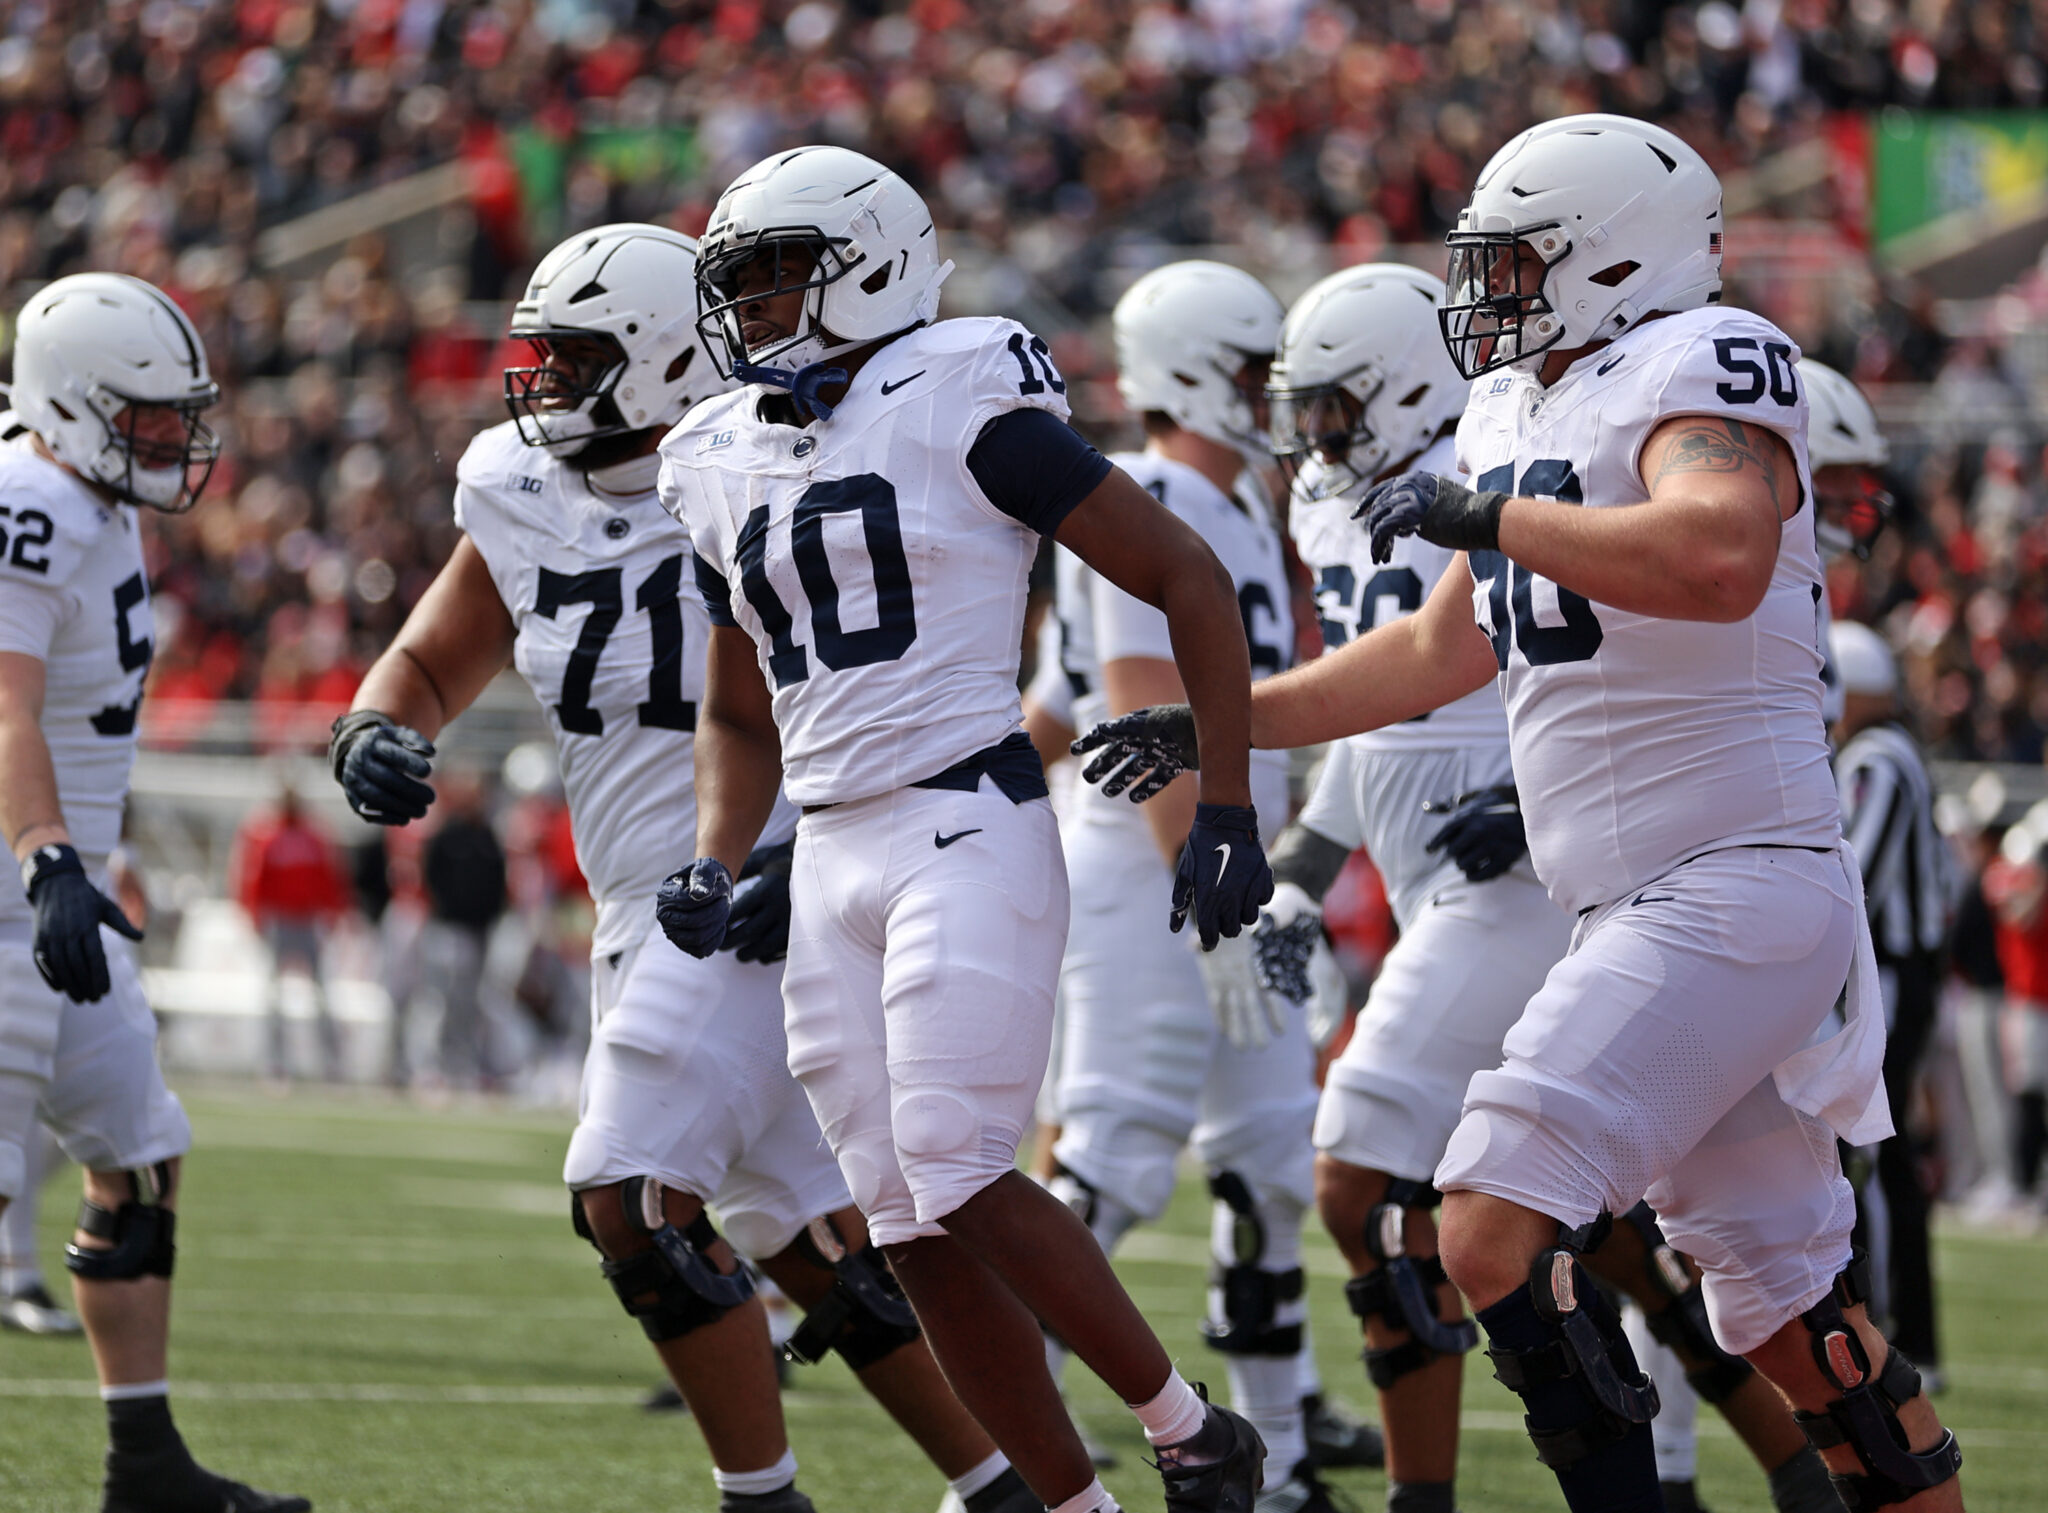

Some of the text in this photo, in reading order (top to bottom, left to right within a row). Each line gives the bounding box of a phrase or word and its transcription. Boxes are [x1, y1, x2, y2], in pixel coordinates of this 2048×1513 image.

[1007, 332, 1066, 396] 10
[1713, 337, 1798, 407] 50
[0, 506, 54, 574] 2
[734, 472, 917, 690] 10
[533, 553, 697, 736] 71
